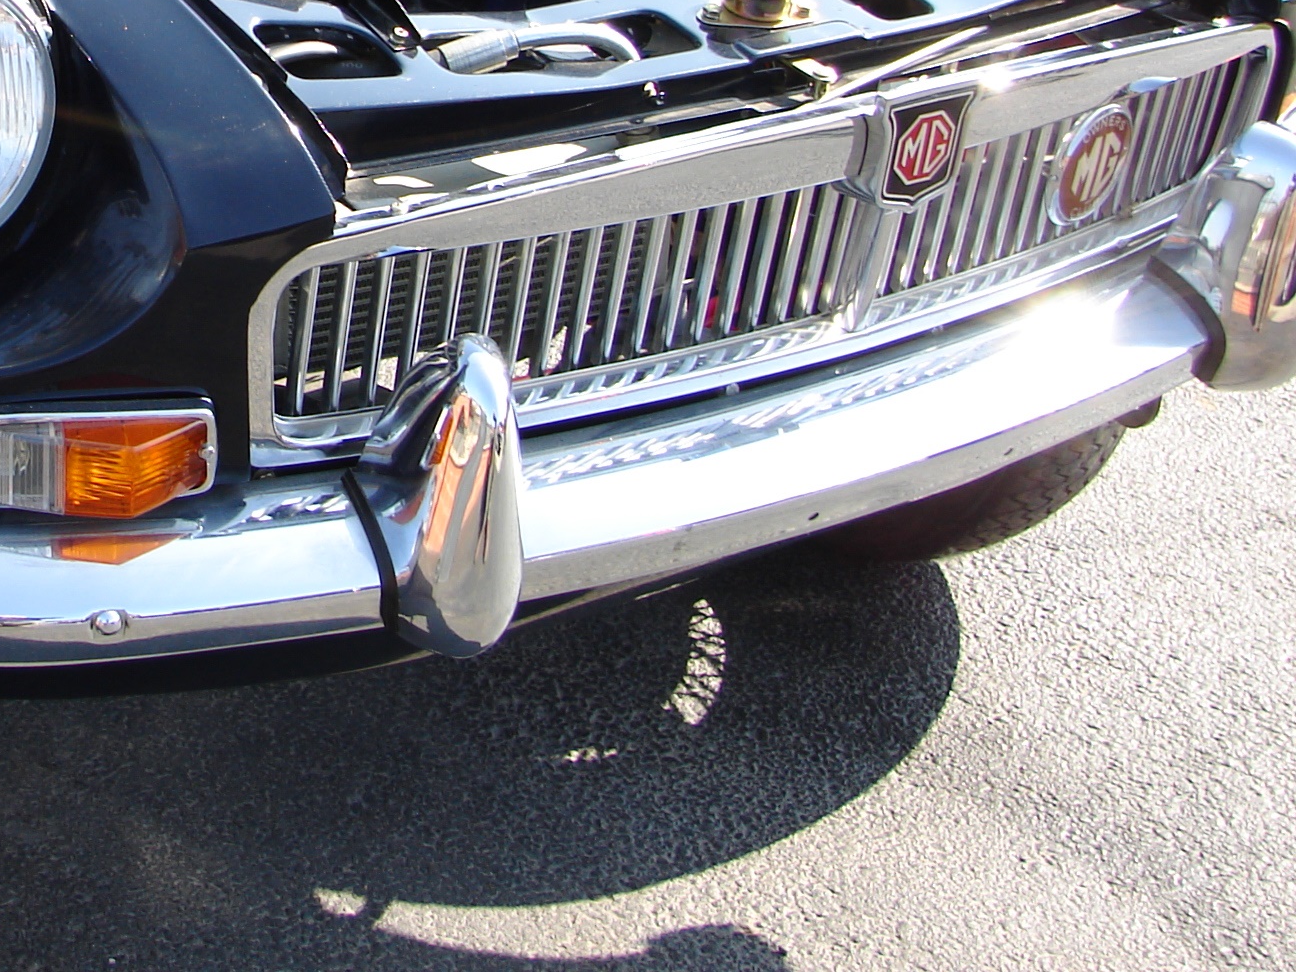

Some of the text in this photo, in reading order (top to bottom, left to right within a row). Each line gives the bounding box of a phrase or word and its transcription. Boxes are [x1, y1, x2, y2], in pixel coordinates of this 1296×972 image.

[901, 117, 950, 177] MG
[1083, 115, 1126, 144] OWNERS
[1071, 131, 1121, 202] MG
